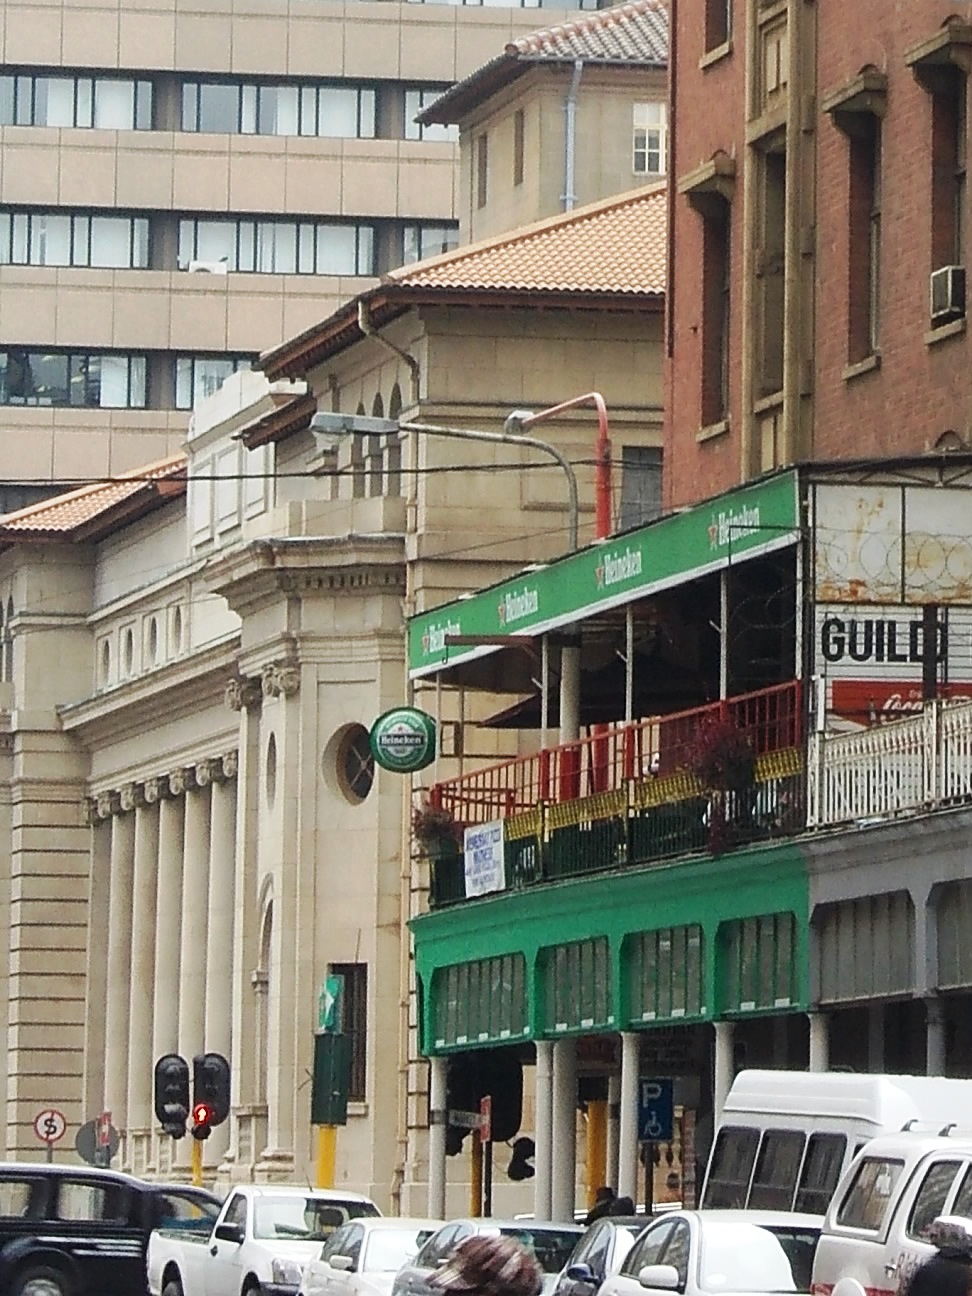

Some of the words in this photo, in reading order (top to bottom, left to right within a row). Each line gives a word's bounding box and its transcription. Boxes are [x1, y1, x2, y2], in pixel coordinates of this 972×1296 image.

[718, 504, 760, 545] Heineken
[604, 547, 642, 585] Heineken
[505, 586, 539, 623] Heineken
[821, 617, 947, 663] GUILD
[381, 735, 421, 745] Heineken
[642, 1083, 662, 1108] P
